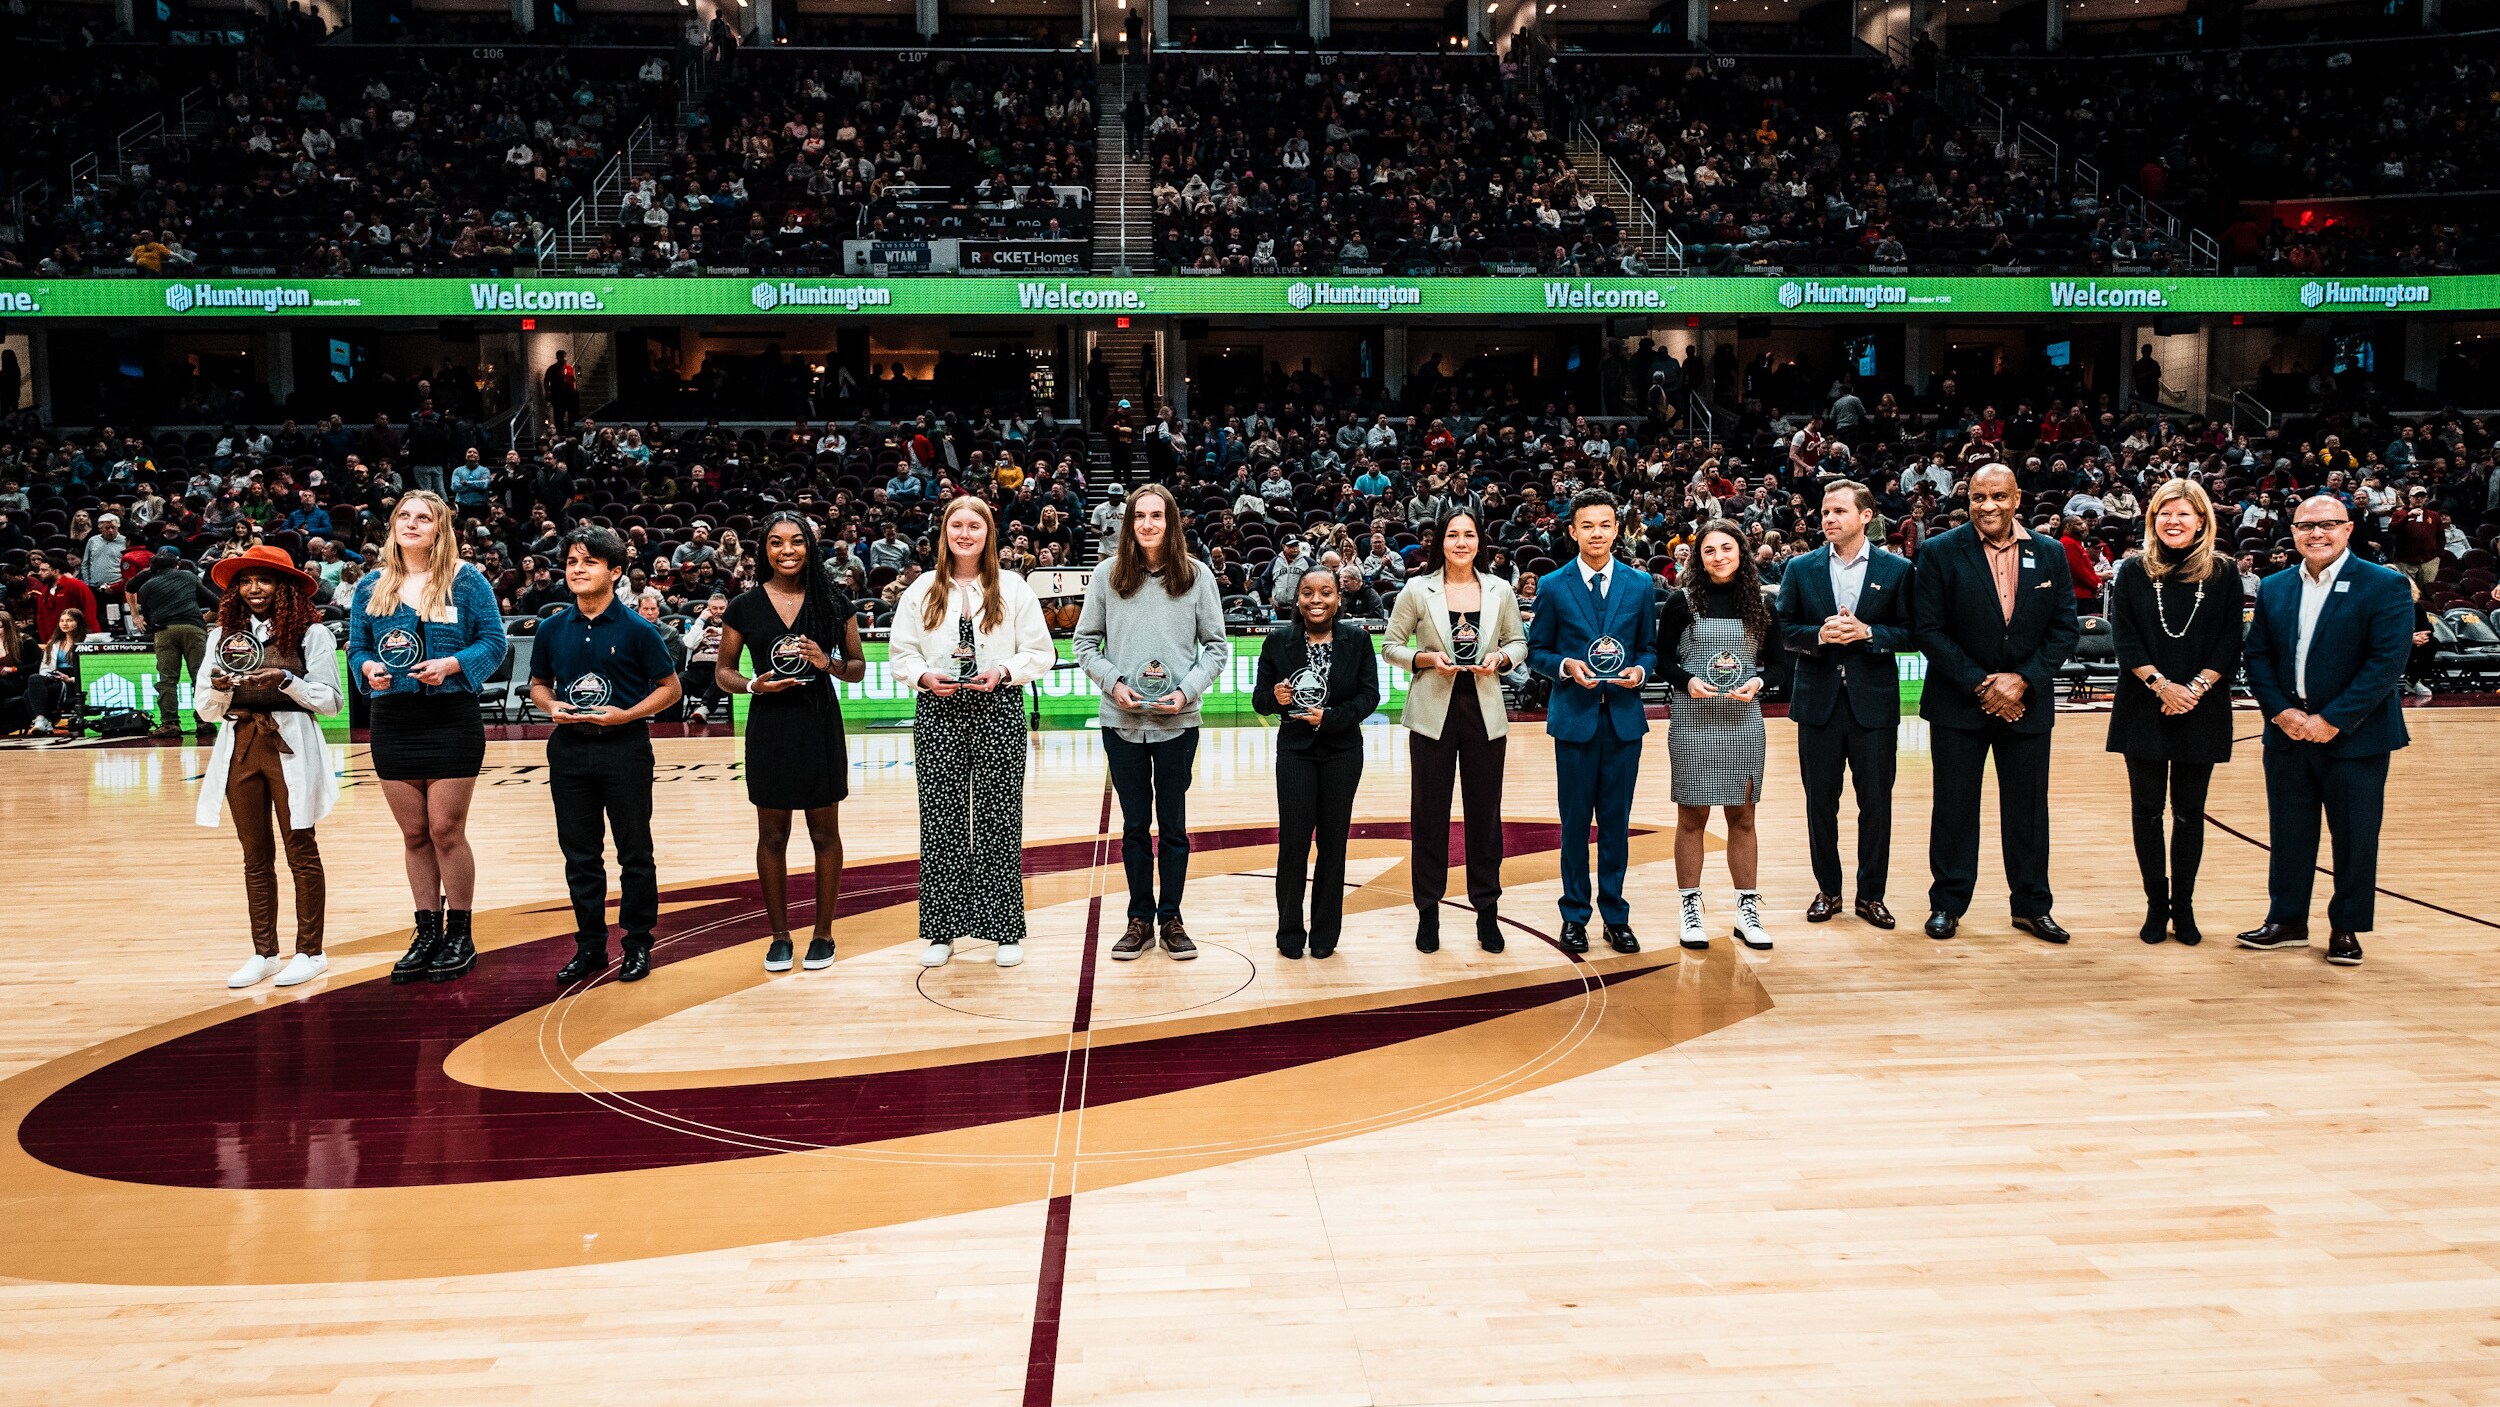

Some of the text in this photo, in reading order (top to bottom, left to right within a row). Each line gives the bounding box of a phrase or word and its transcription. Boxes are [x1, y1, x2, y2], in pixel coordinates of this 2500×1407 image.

[472, 48, 504, 59] C 106
[898, 51, 928, 62] C 107
[1716, 57, 1735, 68] 109
[884, 250, 917, 262] WTAM
[971, 252, 1079, 264] ROCKET Homes
[574, 265, 619, 276] Huntington
[706, 265, 750, 275] Huntington
[959, 266, 1000, 276] Huntington
[1252, 266, 1302, 274] CLUB LEVEL
[1342, 265, 1384, 276] Huntington
[1439, 266, 1463, 275] LEVEL
[1496, 265, 1537, 275] Huntington
[1743, 264, 1784, 274] Huntington
[1868, 263, 1908, 274] Huntington
[195, 283, 311, 312] Huntington
[470, 283, 605, 310] Welcome.
[780, 282, 891, 310] Huntington
[1017, 282, 1147, 309] Welcome.
[1315, 282, 1420, 309] Huntington
[1544, 282, 1666, 308] Welcome.
[1805, 282, 1907, 309] Huntington
[2050, 281, 2168, 307] Welcome.
[2325, 282, 2430, 308] Huntington
[74, 644, 93, 653] ANC
